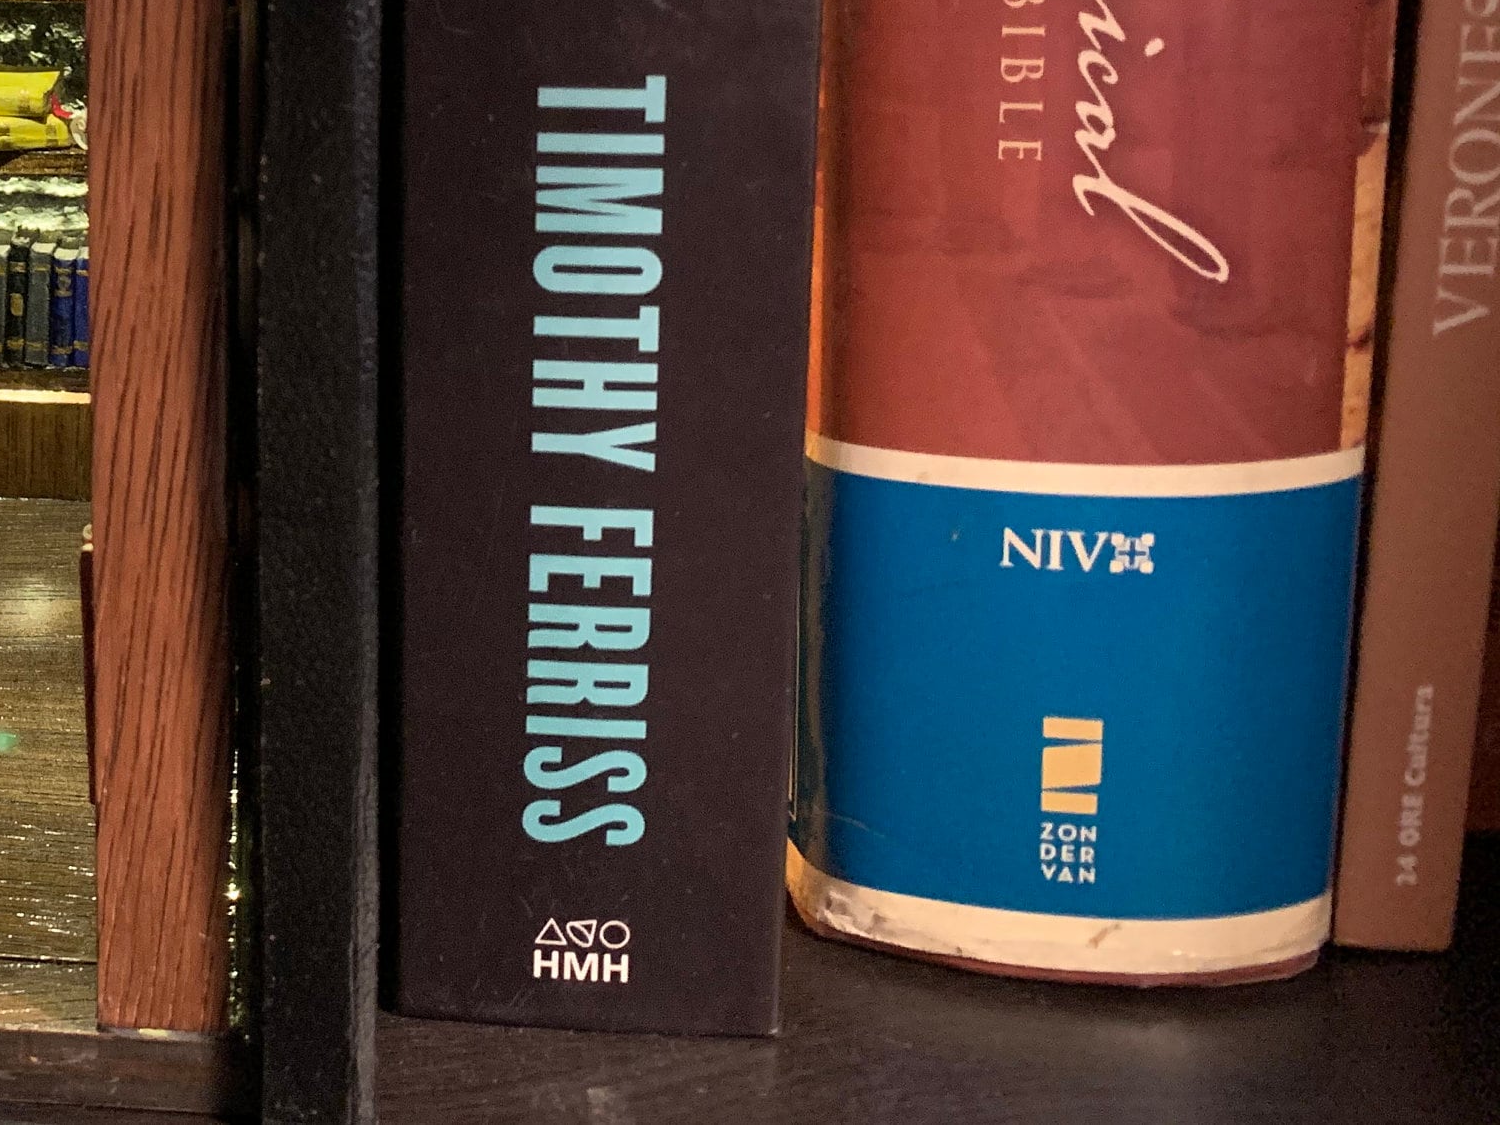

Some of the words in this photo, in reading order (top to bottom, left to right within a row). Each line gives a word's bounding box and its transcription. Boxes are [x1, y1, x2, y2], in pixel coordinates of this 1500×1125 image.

[530, 75, 666, 472] TIMOTHY
[1000, 527, 1108, 572] NIV
[521, 504, 654, 846] FERRISS
[1040, 822, 1098, 842] ZON
[1040, 843, 1096, 864] DER
[1040, 863, 1096, 884] VAN
[532, 949, 630, 984] HMH
